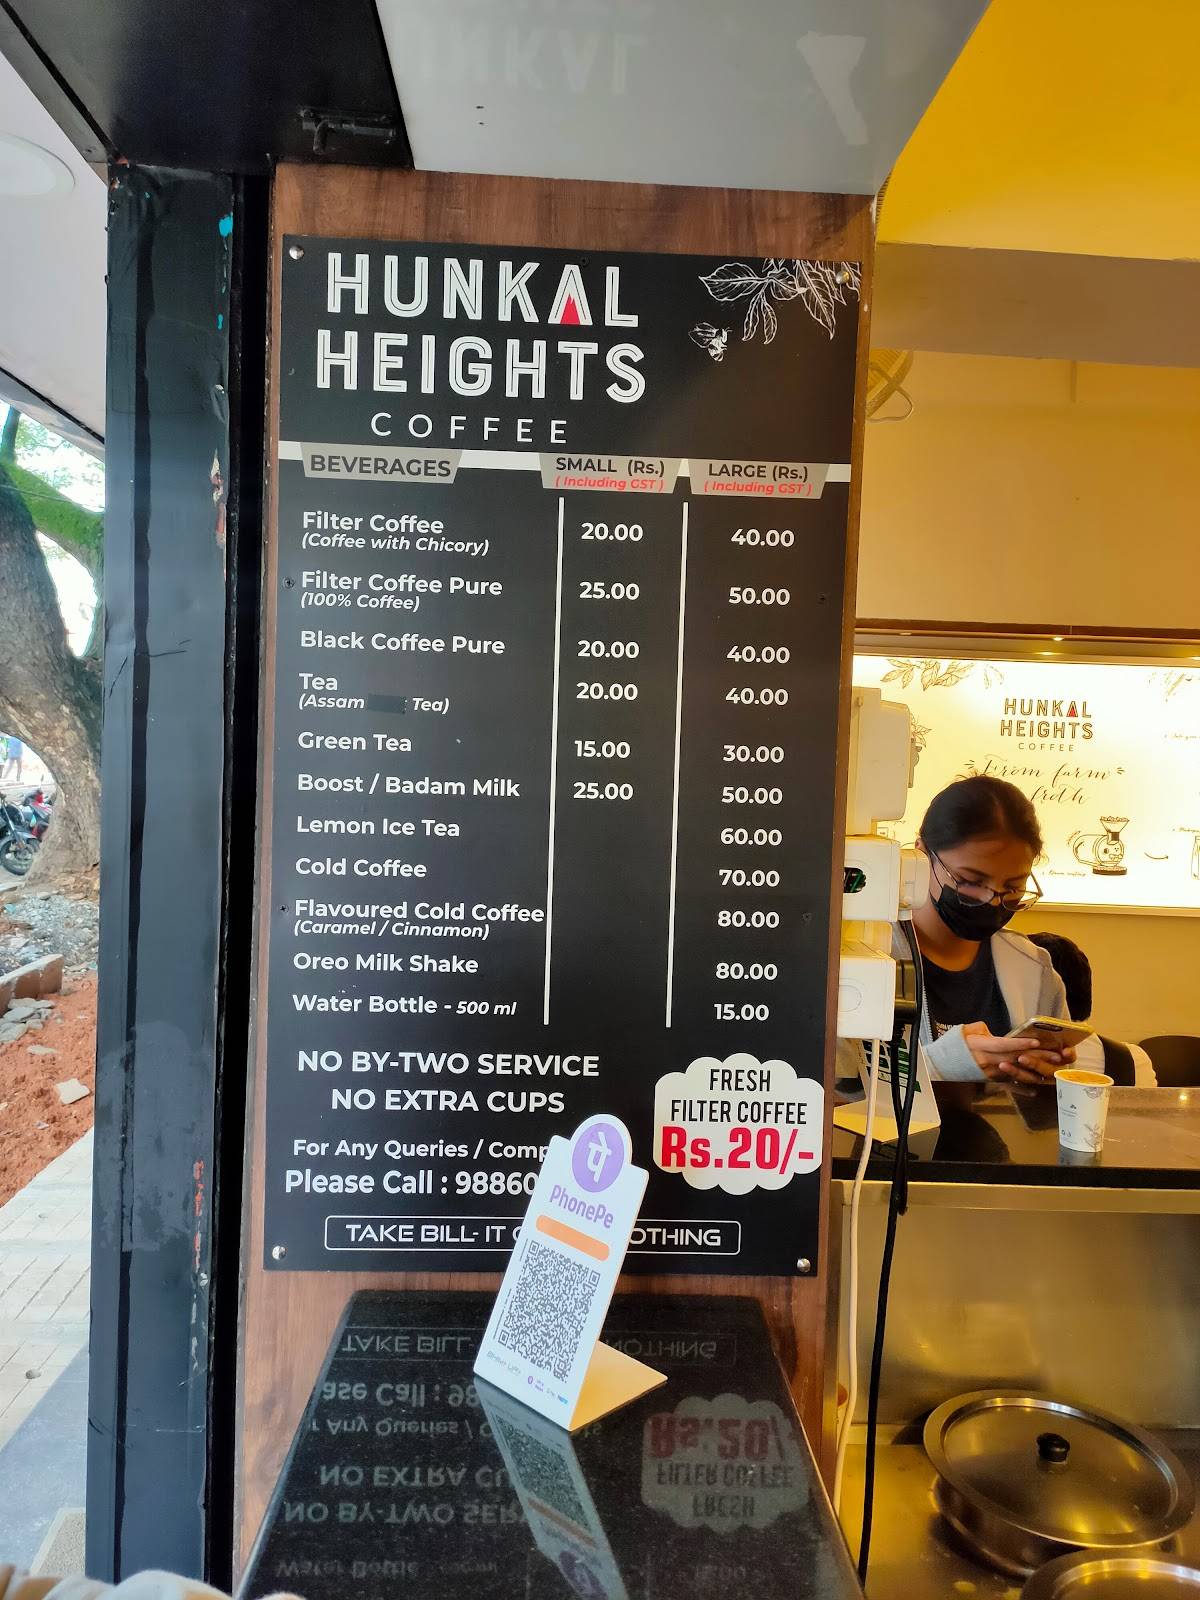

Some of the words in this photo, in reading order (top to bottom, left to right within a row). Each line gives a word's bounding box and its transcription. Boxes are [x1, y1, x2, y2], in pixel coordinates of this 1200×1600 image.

[326, 250, 640, 329] HUNKAL
[316, 328, 646, 403] HEIGHTS
[370, 412, 567, 444] COFFEE
[308, 454, 451, 480] BEVERAGES
[556, 456, 618, 473] SMALL
[627, 459, 665, 478] (Rs.)
[708, 463, 767, 479] LARGE
[772, 465, 808, 483] (Rs.)
[562, 475, 627, 492] Including
[629, 477, 656, 492] GST
[711, 479, 776, 496] Including
[779, 481, 804, 495] GST
[303, 510, 364, 531] Filter
[369, 514, 444, 534] Coffee
[581, 522, 644, 542] 20.00
[301, 531, 366, 550] (Coffee
[370, 534, 407, 550] with
[415, 536, 489, 557] Chicory)
[730, 528, 795, 548] 40.00
[301, 569, 362, 590] Filter
[368, 573, 443, 594] Coffee
[449, 576, 503, 596] Pure
[579, 581, 640, 601] 25.00
[300, 591, 352, 609] (100%
[356, 594, 420, 613] Coffee)
[728, 586, 791, 606] 50.00
[300, 629, 365, 650] Black
[371, 632, 446, 652] Coffee
[452, 635, 506, 655] Pure
[577, 639, 640, 659] 20.00
[726, 645, 791, 664] 40.00
[298, 672, 338, 691] Tea
[576, 681, 639, 701] 20.00
[298, 692, 365, 711] (Assam
[412, 697, 450, 715] Tea)
[725, 687, 789, 706] 40.00
[1004, 698, 1092, 719] HUNKAL
[1000, 720, 1093, 740] HEIGHTS
[298, 731, 367, 751] Green
[372, 733, 412, 752] Tea
[574, 740, 631, 759] 15.00
[1018, 743, 1075, 752] COFFEE
[722, 744, 785, 764] 30.00
[297, 773, 364, 793] Boost
[368, 772, 380, 795] /
[385, 776, 466, 796] Badam
[472, 777, 521, 797] Milk
[1052, 763, 1110, 787] farm
[573, 781, 634, 801] 25.00
[721, 786, 783, 805] 50.00
[297, 815, 375, 835] Lemon
[382, 818, 416, 836] Ice
[421, 819, 460, 837] Tea
[720, 827, 783, 846] 60.00
[295, 857, 347, 876] Cold
[353, 858, 427, 878] Coffee
[718, 869, 780, 888] 70.00
[295, 898, 408, 919] Flavoured
[414, 902, 465, 921] Cold
[471, 903, 545, 923] Coffee
[717, 910, 780, 929] 80.00
[293, 919, 377, 937] (Caramel
[379, 919, 390, 937] /
[391, 921, 490, 941] Cinnamon)
[293, 952, 349, 971] Oreo
[355, 952, 404, 972] Milk
[409, 954, 479, 974] Shake
[715, 962, 778, 981] 80.00
[292, 994, 363, 1012] Water
[368, 995, 438, 1014] Bottle
[455, 1000, 490, 1015] 500
[493, 1001, 518, 1016] ml
[713, 1003, 770, 1021] 15.00
[298, 1050, 343, 1072] NO
[351, 1050, 470, 1074] BY-TWO
[477, 1053, 600, 1077] SERVICE
[709, 1068, 771, 1092] FRESH
[331, 1088, 376, 1110] NO
[385, 1089, 480, 1112] EXTRA
[486, 1090, 565, 1114] CUPS
[671, 1099, 732, 1123] FILTER
[737, 1100, 808, 1125] COFFEE
[293, 1139, 330, 1156] For
[334, 1139, 379, 1161] Any
[383, 1139, 469, 1160] Queries
[472, 1138, 485, 1160] /
[486, 1139, 548, 1163] Comp
[661, 1127, 815, 1174] Rs.20/-
[285, 1169, 375, 1194] Please
[382, 1171, 433, 1194] Call
[440, 1175, 448, 1195] :
[455, 1172, 536, 1196] 98860
[549, 1185, 614, 1230] PhonePe
[345, 1224, 415, 1242] TAKE
[420, 1224, 479, 1243] BILL-
[485, 1225, 507, 1243] IT
[630, 1225, 722, 1247] OTHING
